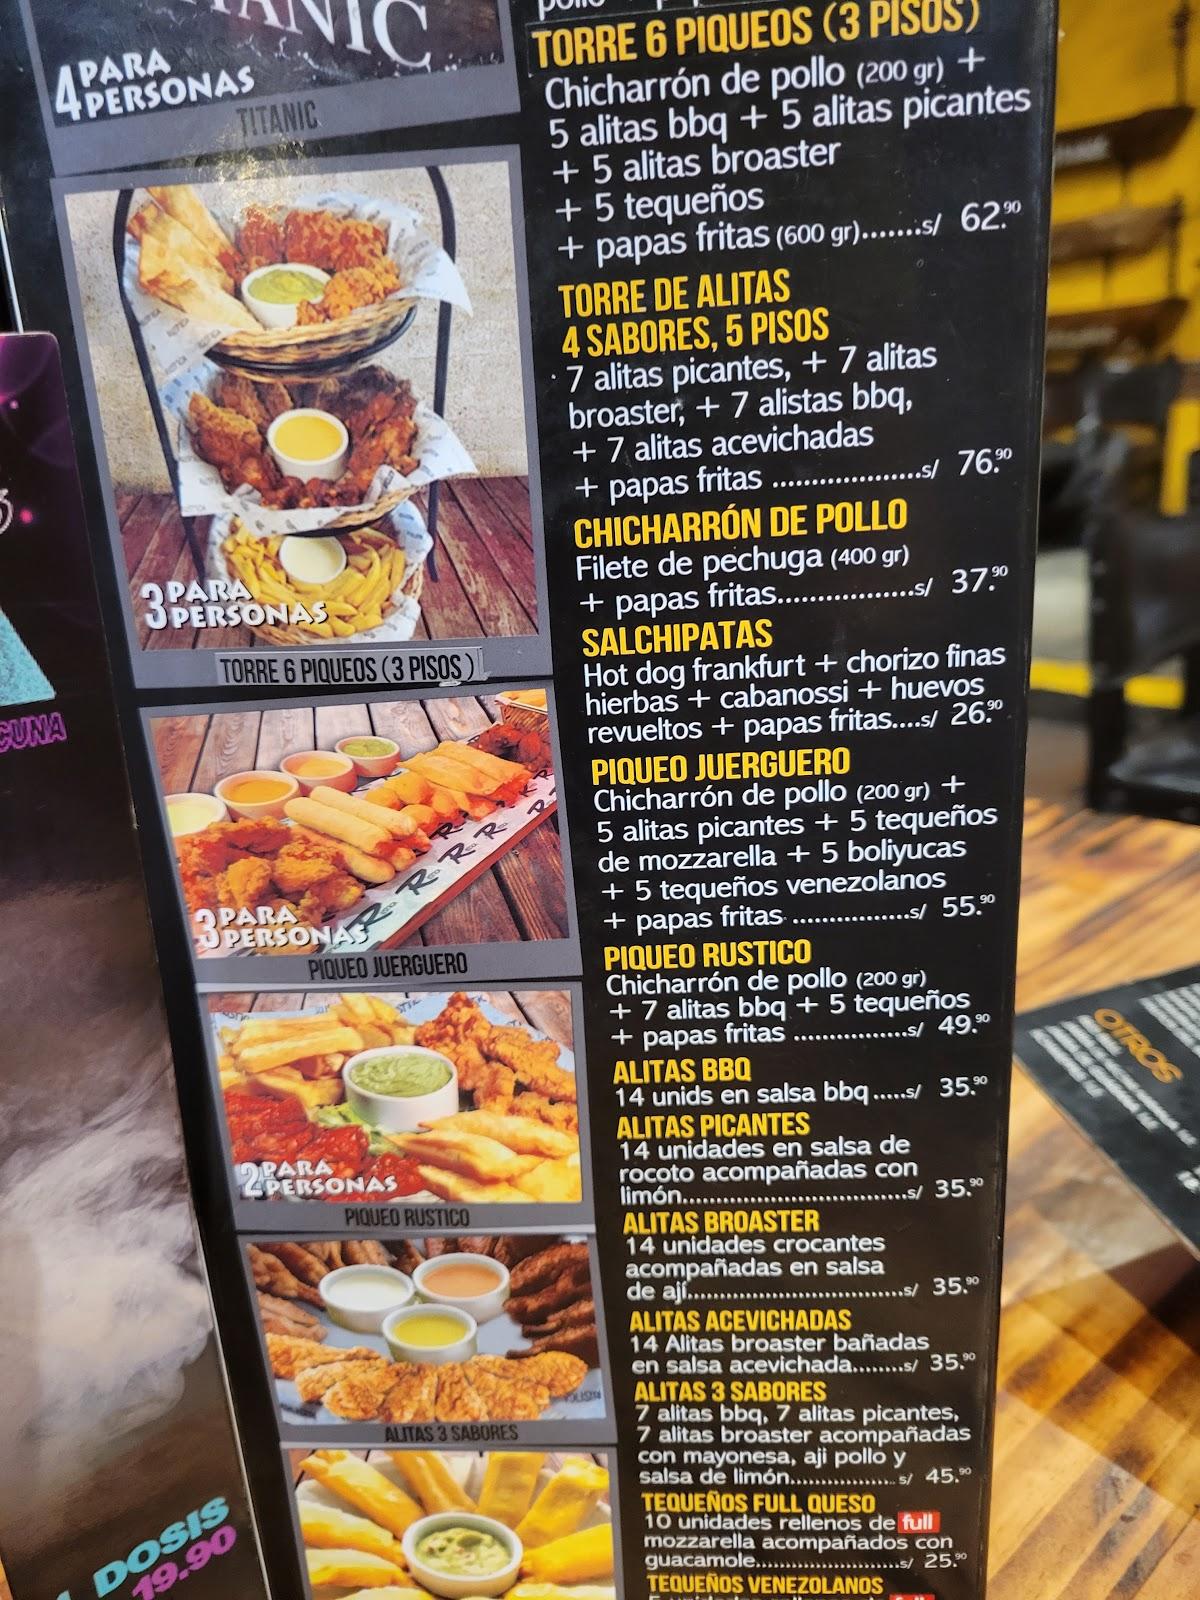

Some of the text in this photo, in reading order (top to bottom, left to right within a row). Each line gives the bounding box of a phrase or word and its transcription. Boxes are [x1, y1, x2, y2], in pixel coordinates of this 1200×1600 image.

[532, 0, 980, 68] TORRE 6 PIQUEOS (3 PISOS)
[55, 47, 171, 121] 4 PARA
[86, 65, 254, 119] PERSONAS
[544, 56, 908, 110] Chicharrón pollo (200
[236, 101, 319, 136] TITANIC
[668, 86, 1032, 144] bbq picantes
[712, 140, 842, 174] broaster
[624, 184, 764, 226] tequeños
[696, 222, 770, 252] fritas
[776, 224, 826, 250] (600
[558, 268, 790, 318] TORRE DE ALITAS
[562, 306, 830, 358] 4 SABORES, 5 PISOS
[594, 356, 790, 394] alitas picantes,
[568, 380, 912, 430] broaster, alistas bbq,
[712, 420, 874, 456] acevichadas
[696, 466, 762, 492] fritas
[574, 498, 908, 548] CHICHARRÓN DE POLLO
[576, 544, 910, 582] Filete pechuga (400 gr)
[141, 578, 252, 630] 3 PARA
[172, 601, 328, 630] PERSONAS
[582, 618, 772, 658] SALCHIPATAS
[220, 657, 279, 684] TORRE
[284, 662, 296, 683] 6
[301, 657, 377, 683] PIQUEOS
[584, 644, 1006, 690] Hot dog frankfurt chorizo finas
[586, 676, 984, 716] hierbas cabanossi huevos
[588, 716, 702, 744] revueltos
[744, 716, 822, 742] papas
[592, 746, 850, 786] PIQUEO JUERGUERO
[594, 778, 900, 812] Chicharrón pollo (200
[698, 804, 998, 844] picantes tequeños
[638, 838, 966, 872] mozzarella boliyucas
[660, 868, 946, 904] tequeños venezolanos
[196, 906, 300, 948] 3 PARA
[720, 904, 784, 926] fritas
[221, 924, 369, 948] PERSONAS
[309, 952, 467, 980] PIQUEO JUERGUERO
[604, 938, 812, 970] PIQUEO RUSTICO
[606, 966, 898, 996] Chicharrón pollo (200
[666, 990, 970, 1022] alitas bbq tequeños
[724, 1022, 786, 1044] fritas
[1094, 1008, 1183, 1083] OTROS
[614, 1056, 752, 1084] ALITAS BBQ
[616, 1086, 644, 1106] 14
[652, 1084, 714, 1106] unids
[824, 1080, 868, 1106] bbq
[616, 1112, 810, 1140] ALITAS PICANTES
[620, 1138, 764, 1160] 14 unidades
[240, 1160, 333, 1197] 2 PARA
[264, 1176, 398, 1197] PERSONAS
[620, 1158, 868, 1186] rocoto acompañadas
[344, 1208, 469, 1227] PIQUEO RUSTICO
[622, 1210, 820, 1234] ALITAS BROASTER
[626, 1234, 886, 1256] 14 unidades crocantes
[626, 1258, 782, 1282] acompañadas
[630, 1308, 852, 1332] ALITAS ACEVICHADAS
[630, 1332, 930, 1352] 14 Alitas broaster bañadas
[666, 1356, 722, 1374] salsa
[634, 1380, 826, 1402] ALITAS 3 SABORES
[720, 1404, 960, 1426] bbq, picantes,
[385, 1424, 518, 1443] ALITAS 3 SABORES
[722, 1424, 972, 1448] broaster acompañadas
[684, 1450, 796, 1468] mayonesa,
[834, 1448, 886, 1468] pollo
[640, 1490, 876, 1514] TEQUEÑOS FULL QUESO
[646, 1511, 933, 1530] 10 unidades rellenos full
[92, 1497, 229, 1598] DOSIS
[644, 1534, 908, 1554] mozzarella acompañados
[132, 1525, 237, 1600] 19.90
[646, 1572, 884, 1594] TEQUEÑOS VENEZOLANOS
